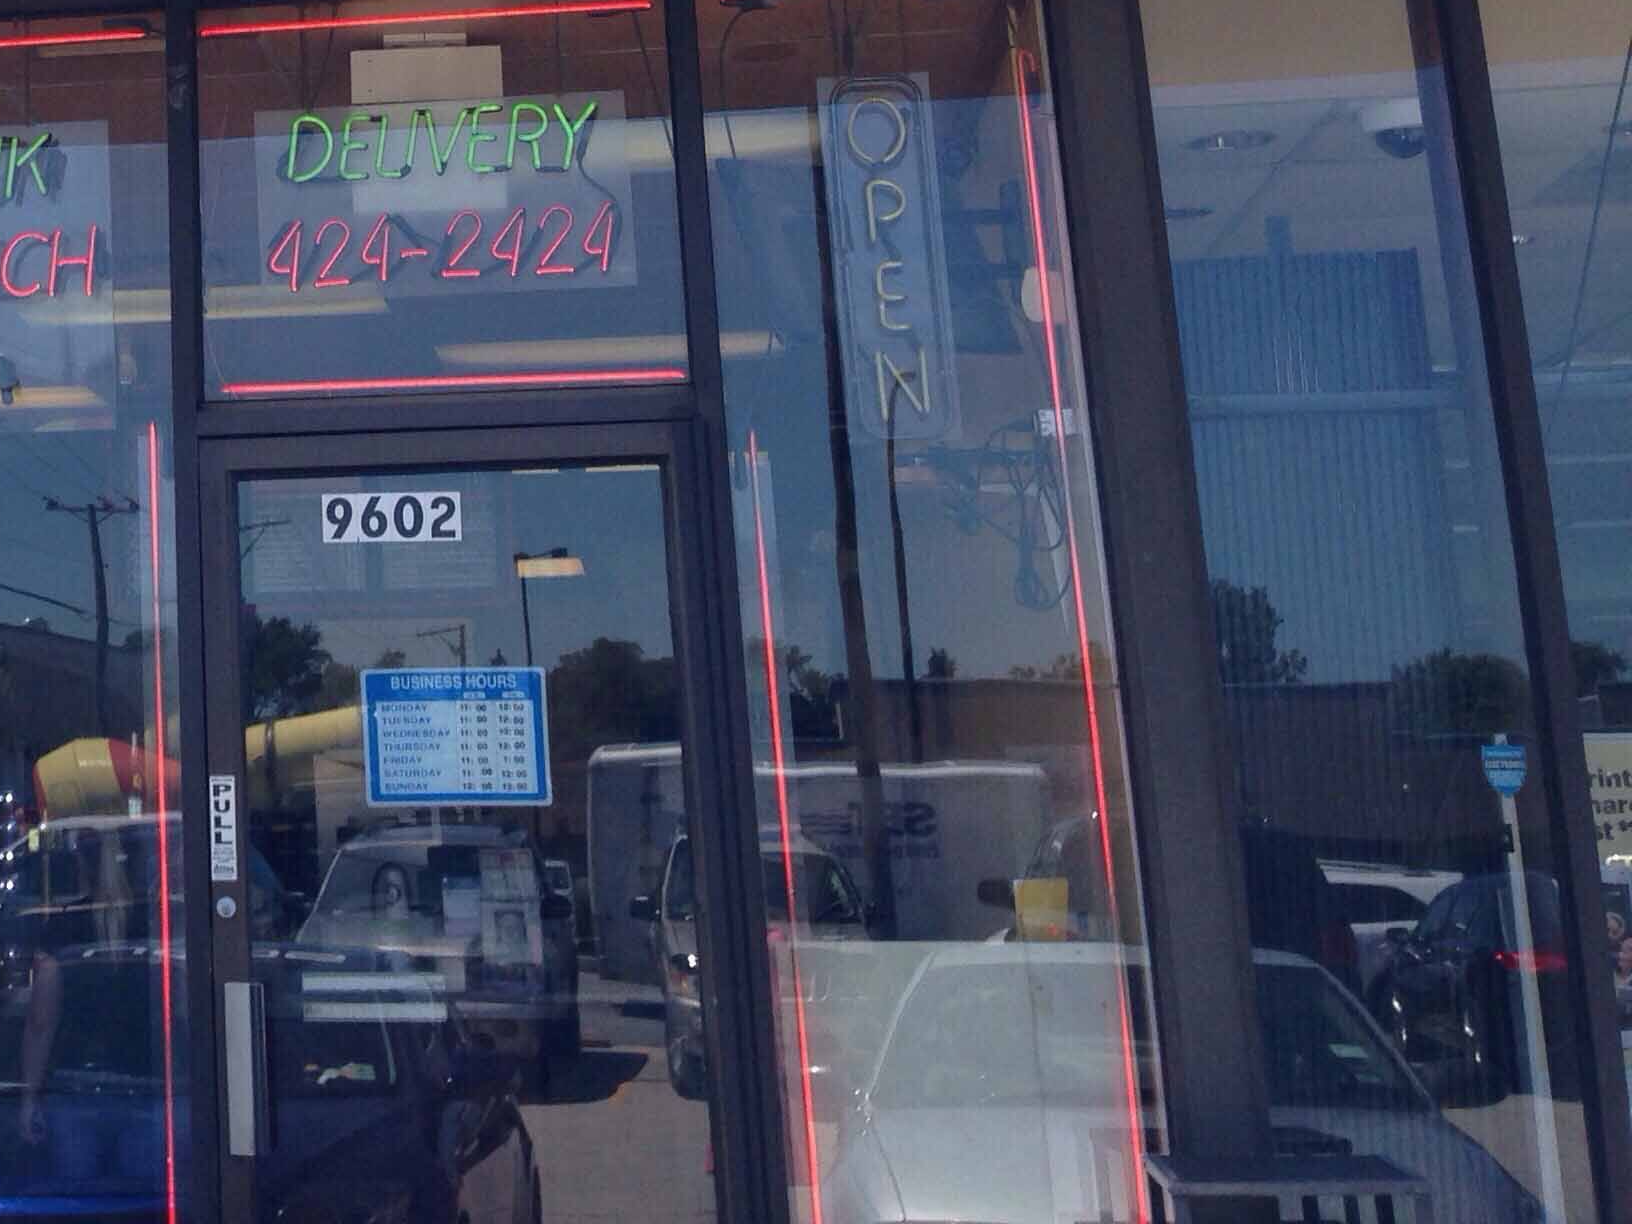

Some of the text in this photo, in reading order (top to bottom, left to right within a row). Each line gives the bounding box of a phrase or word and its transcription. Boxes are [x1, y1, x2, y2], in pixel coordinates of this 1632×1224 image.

[287, 102, 599, 182] DELIVERY
[270, 201, 615, 292] 424-2424
[848, 98, 930, 422] OPEN
[326, 496, 456, 540] 9602
[391, 675, 517, 690] BUSINESS HOURS
[212, 784, 233, 846] PULL
